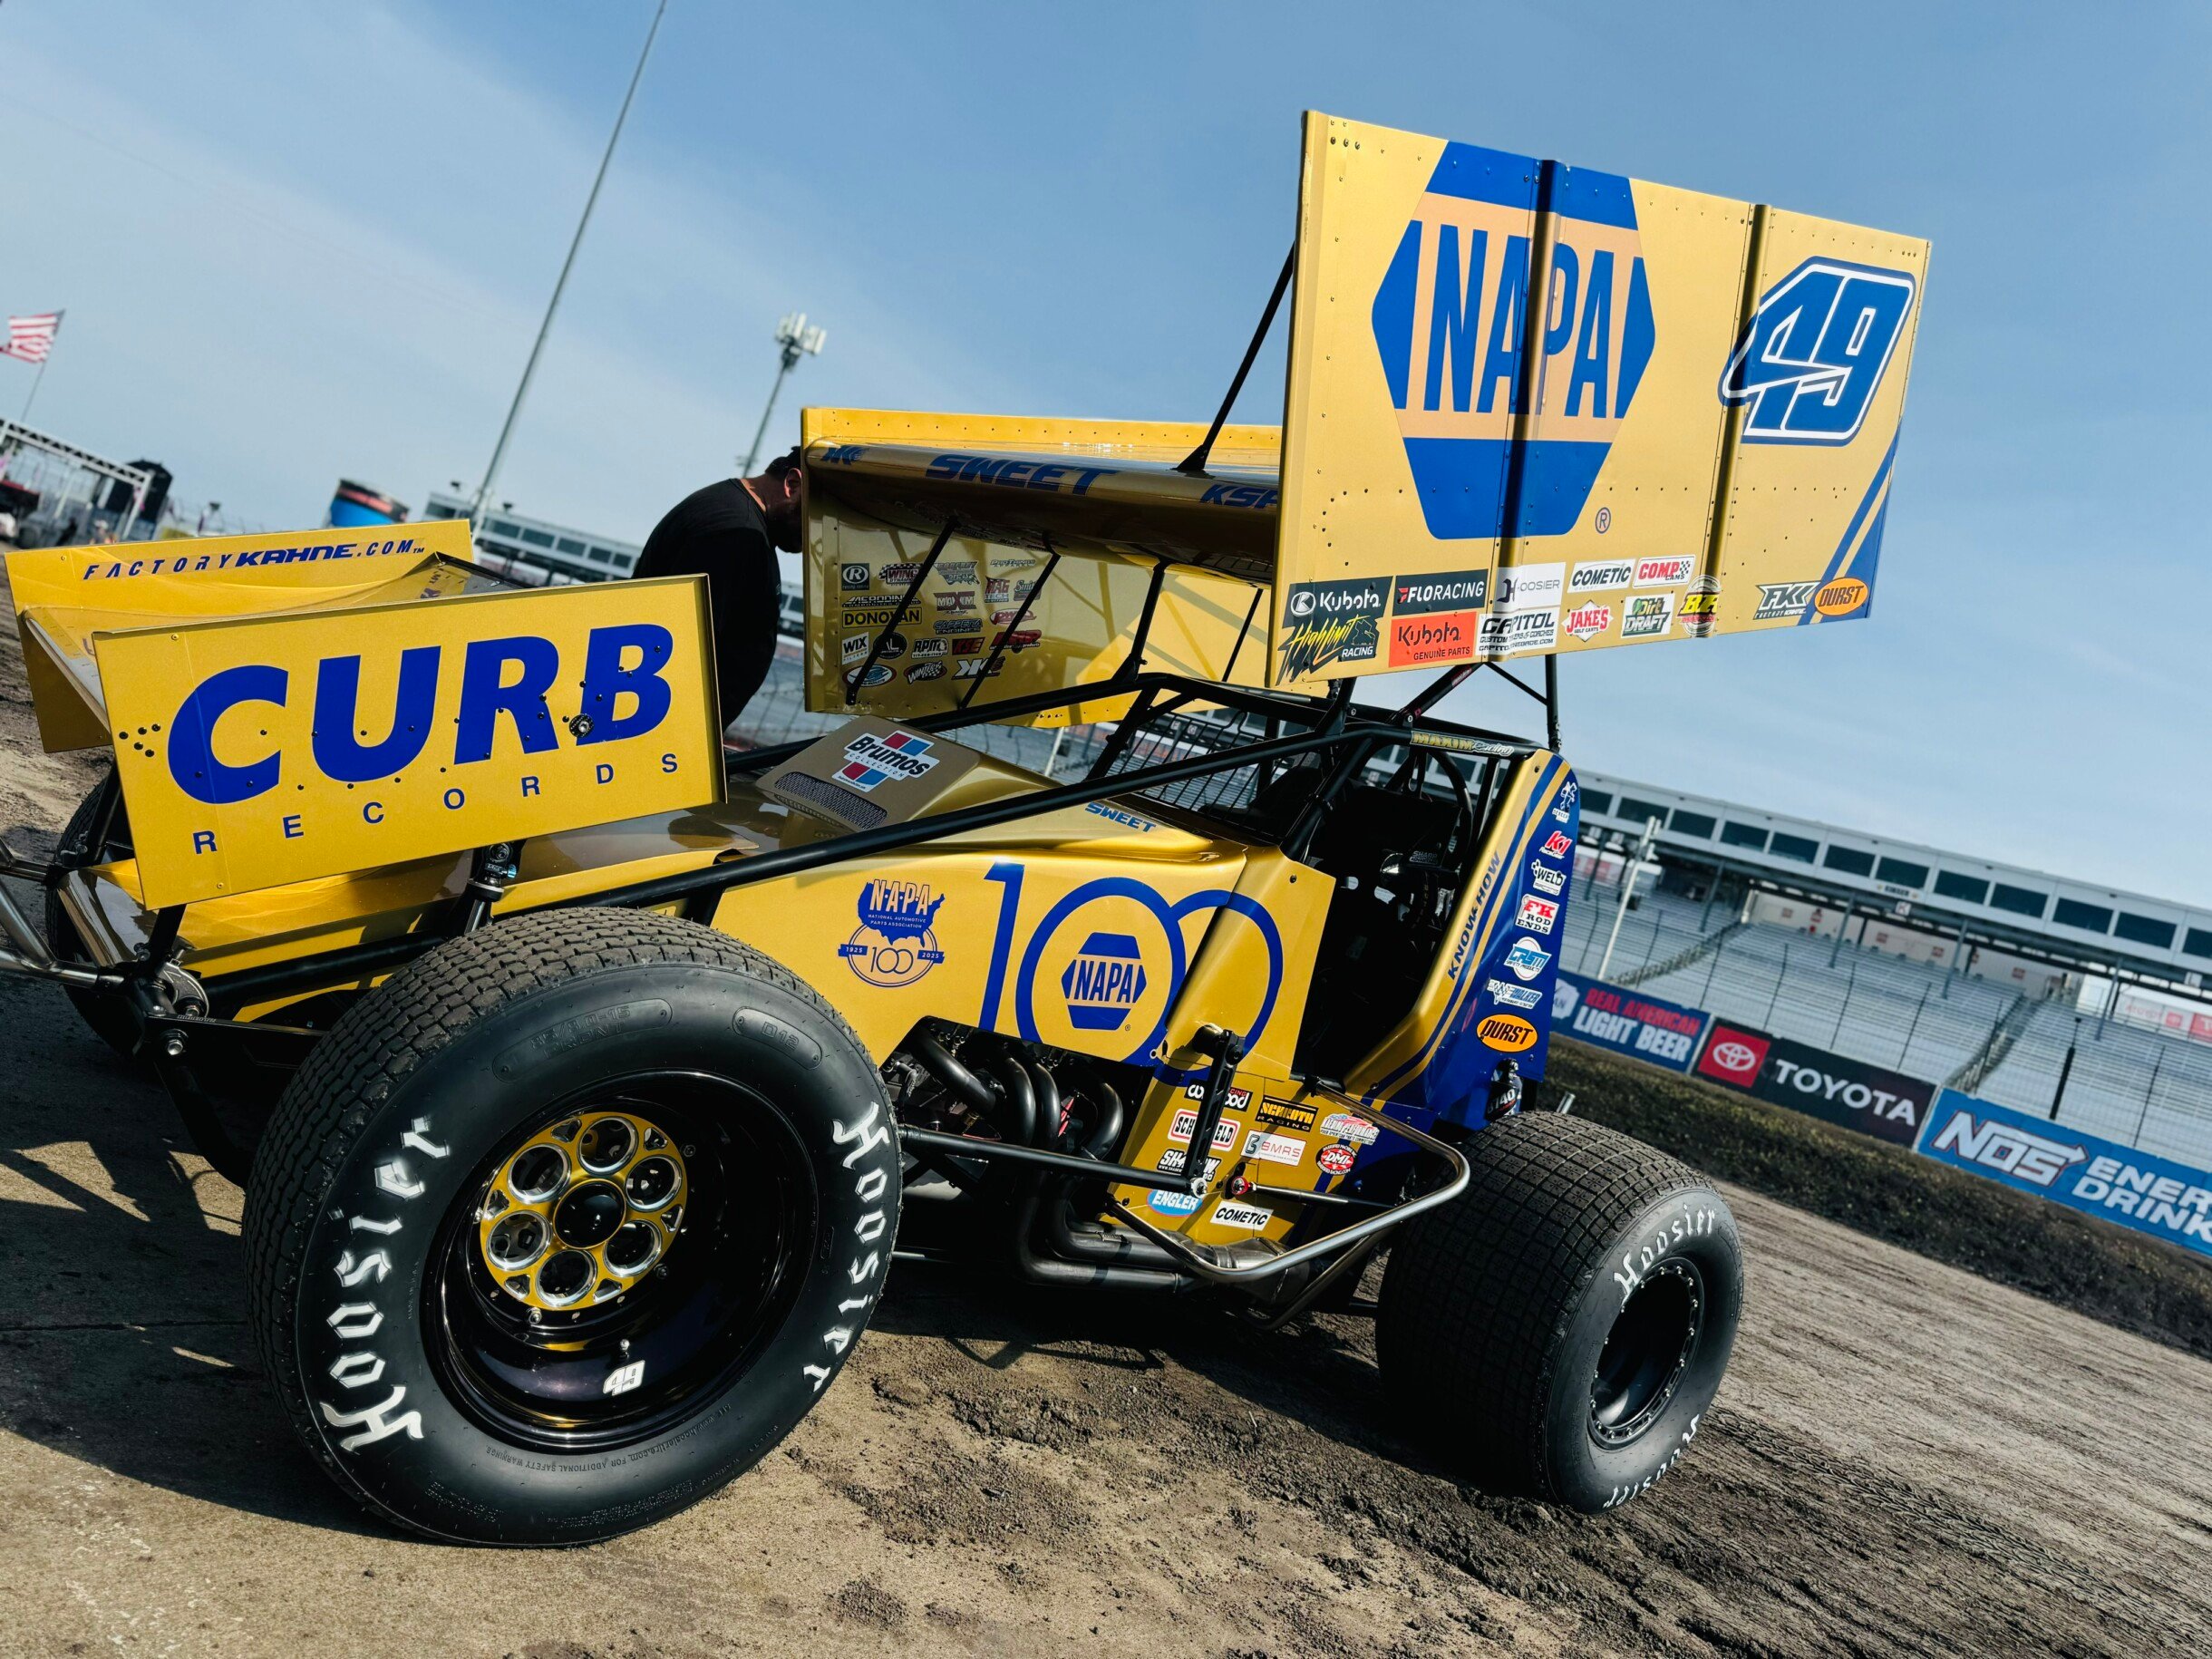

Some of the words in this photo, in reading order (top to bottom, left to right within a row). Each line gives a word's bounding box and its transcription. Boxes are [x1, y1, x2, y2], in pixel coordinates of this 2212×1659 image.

[1422, 222, 1615, 419] NAPA
[1722, 257, 1915, 444] 49
[925, 453, 1121, 497] SWEET
[1571, 566, 1632, 587] COMETIC
[1637, 560, 1680, 580] COMP
[1664, 573, 1685, 581] CAMS
[1319, 590, 1382, 613] Kubota
[1641, 597, 1665, 616] Dirt
[1818, 585, 1865, 607] DURST
[1398, 621, 1460, 646] Kubota
[1624, 614, 1669, 632] DRAFT
[843, 636, 868, 654] WIX
[1342, 645, 1373, 658] RACING
[1413, 648, 1447, 661] GENUINE
[1448, 646, 1470, 657] PARTS
[167, 623, 674, 805] CURB
[1413, 732, 1473, 751] MAXIM
[847, 735, 931, 775] Brumos
[849, 753, 905, 778] COLLECTION
[191, 752, 678, 855] RECORDS
[1084, 801, 1157, 832] SWEET
[1544, 830, 1573, 856] K1
[1536, 868, 1564, 886] WELD
[1523, 900, 1556, 919] FK
[1526, 913, 1551, 926] ROD
[1517, 918, 1549, 934] ENDS
[870, 946, 914, 975] 100
[978, 861, 1284, 1068] 100
[1075, 959, 1136, 1004] NAPA
[1585, 987, 1621, 1014] REAL
[1622, 1000, 1701, 1037] AMERICAN
[762, 1021, 800, 1053] D12
[1480, 1019, 1534, 1045] DURST
[1573, 1005, 1639, 1044] LIGHT
[1635, 1024, 1693, 1062] BEER
[1775, 1059, 1916, 1127] TOYOTA
[1256, 1115, 1310, 1130] RACING
[1259, 1102, 1315, 1124] SCHROTH
[1324, 1151, 1351, 1165] DMI
[1932, 1110, 2088, 1188] NOS
[1151, 1189, 1199, 1211] ENGLER
[2071, 1176, 2212, 1246] DRINK
[1215, 1207, 1269, 1226] COMETIC
[802, 1101, 891, 1392] Hoosier
[1613, 1202, 1717, 1301] Hoosier
[319, 1116, 451, 1452] Hoosier
[602, 1360, 645, 1396] 49
[525, 1460, 557, 1472] SAFETY
[558, 1460, 606, 1472] ADDITIONAL
[610, 1457, 626, 1468] FOR
